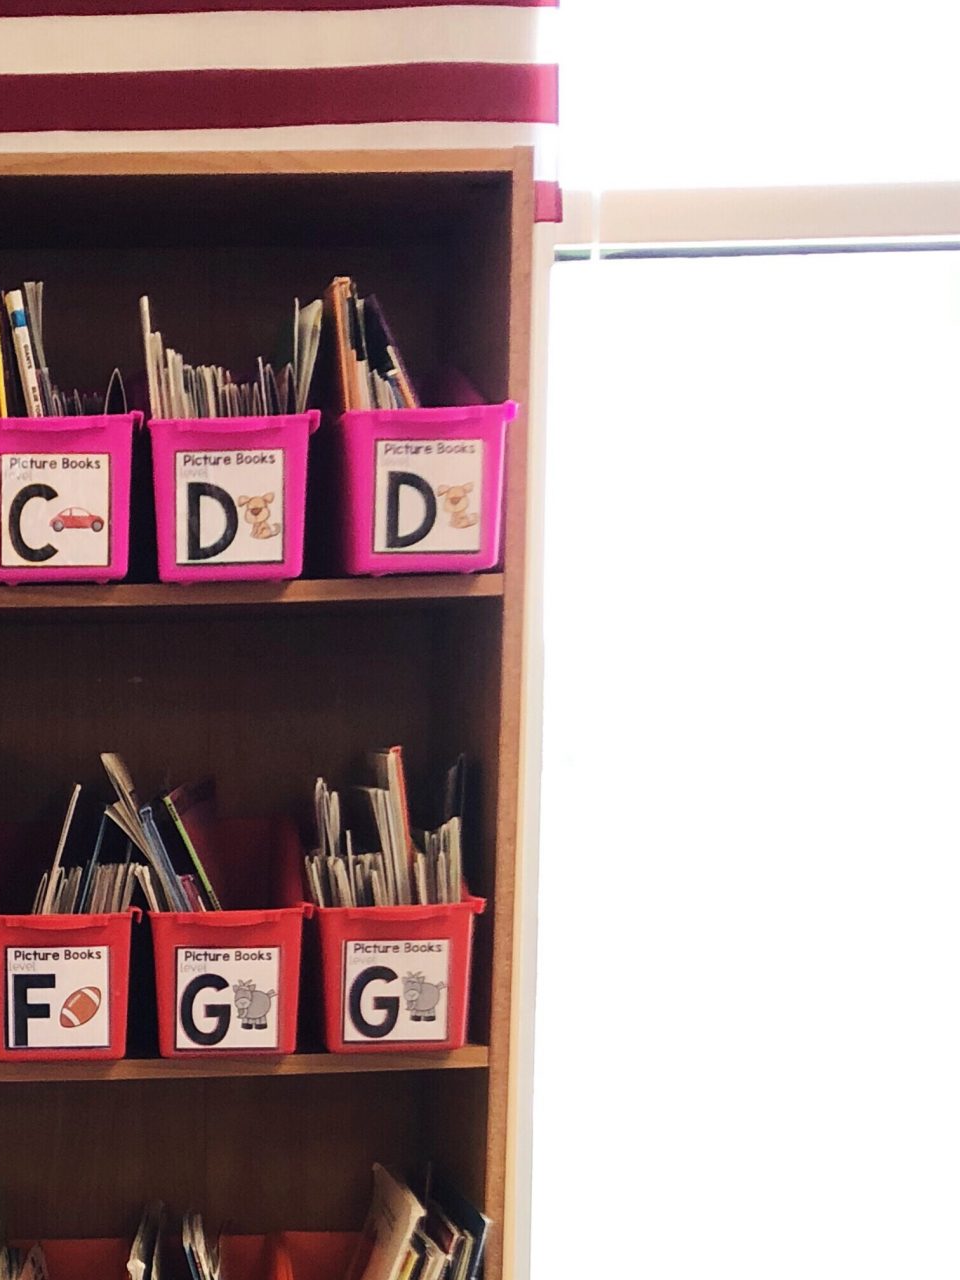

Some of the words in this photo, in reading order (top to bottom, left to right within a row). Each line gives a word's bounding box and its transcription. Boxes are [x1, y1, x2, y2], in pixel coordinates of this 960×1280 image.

[9, 457, 57, 470] Picture
[62, 457, 101, 470] Books
[183, 453, 231, 467] Picture
[236, 452, 275, 465] Books
[384, 443, 432, 455] Picture
[437, 442, 476, 454] Books
[8, 483, 58, 562] C
[187, 482, 239, 560] D
[386, 471, 437, 549] D
[13, 949, 60, 963] Picture
[63, 949, 102, 961] Books
[184, 950, 231, 963] Picture
[234, 949, 272, 962] Books
[353, 942, 400, 955] Picture
[404, 941, 443, 954] Books
[12, 973, 56, 1046] F
[180, 973, 231, 1046] G
[350, 965, 401, 1038] G
